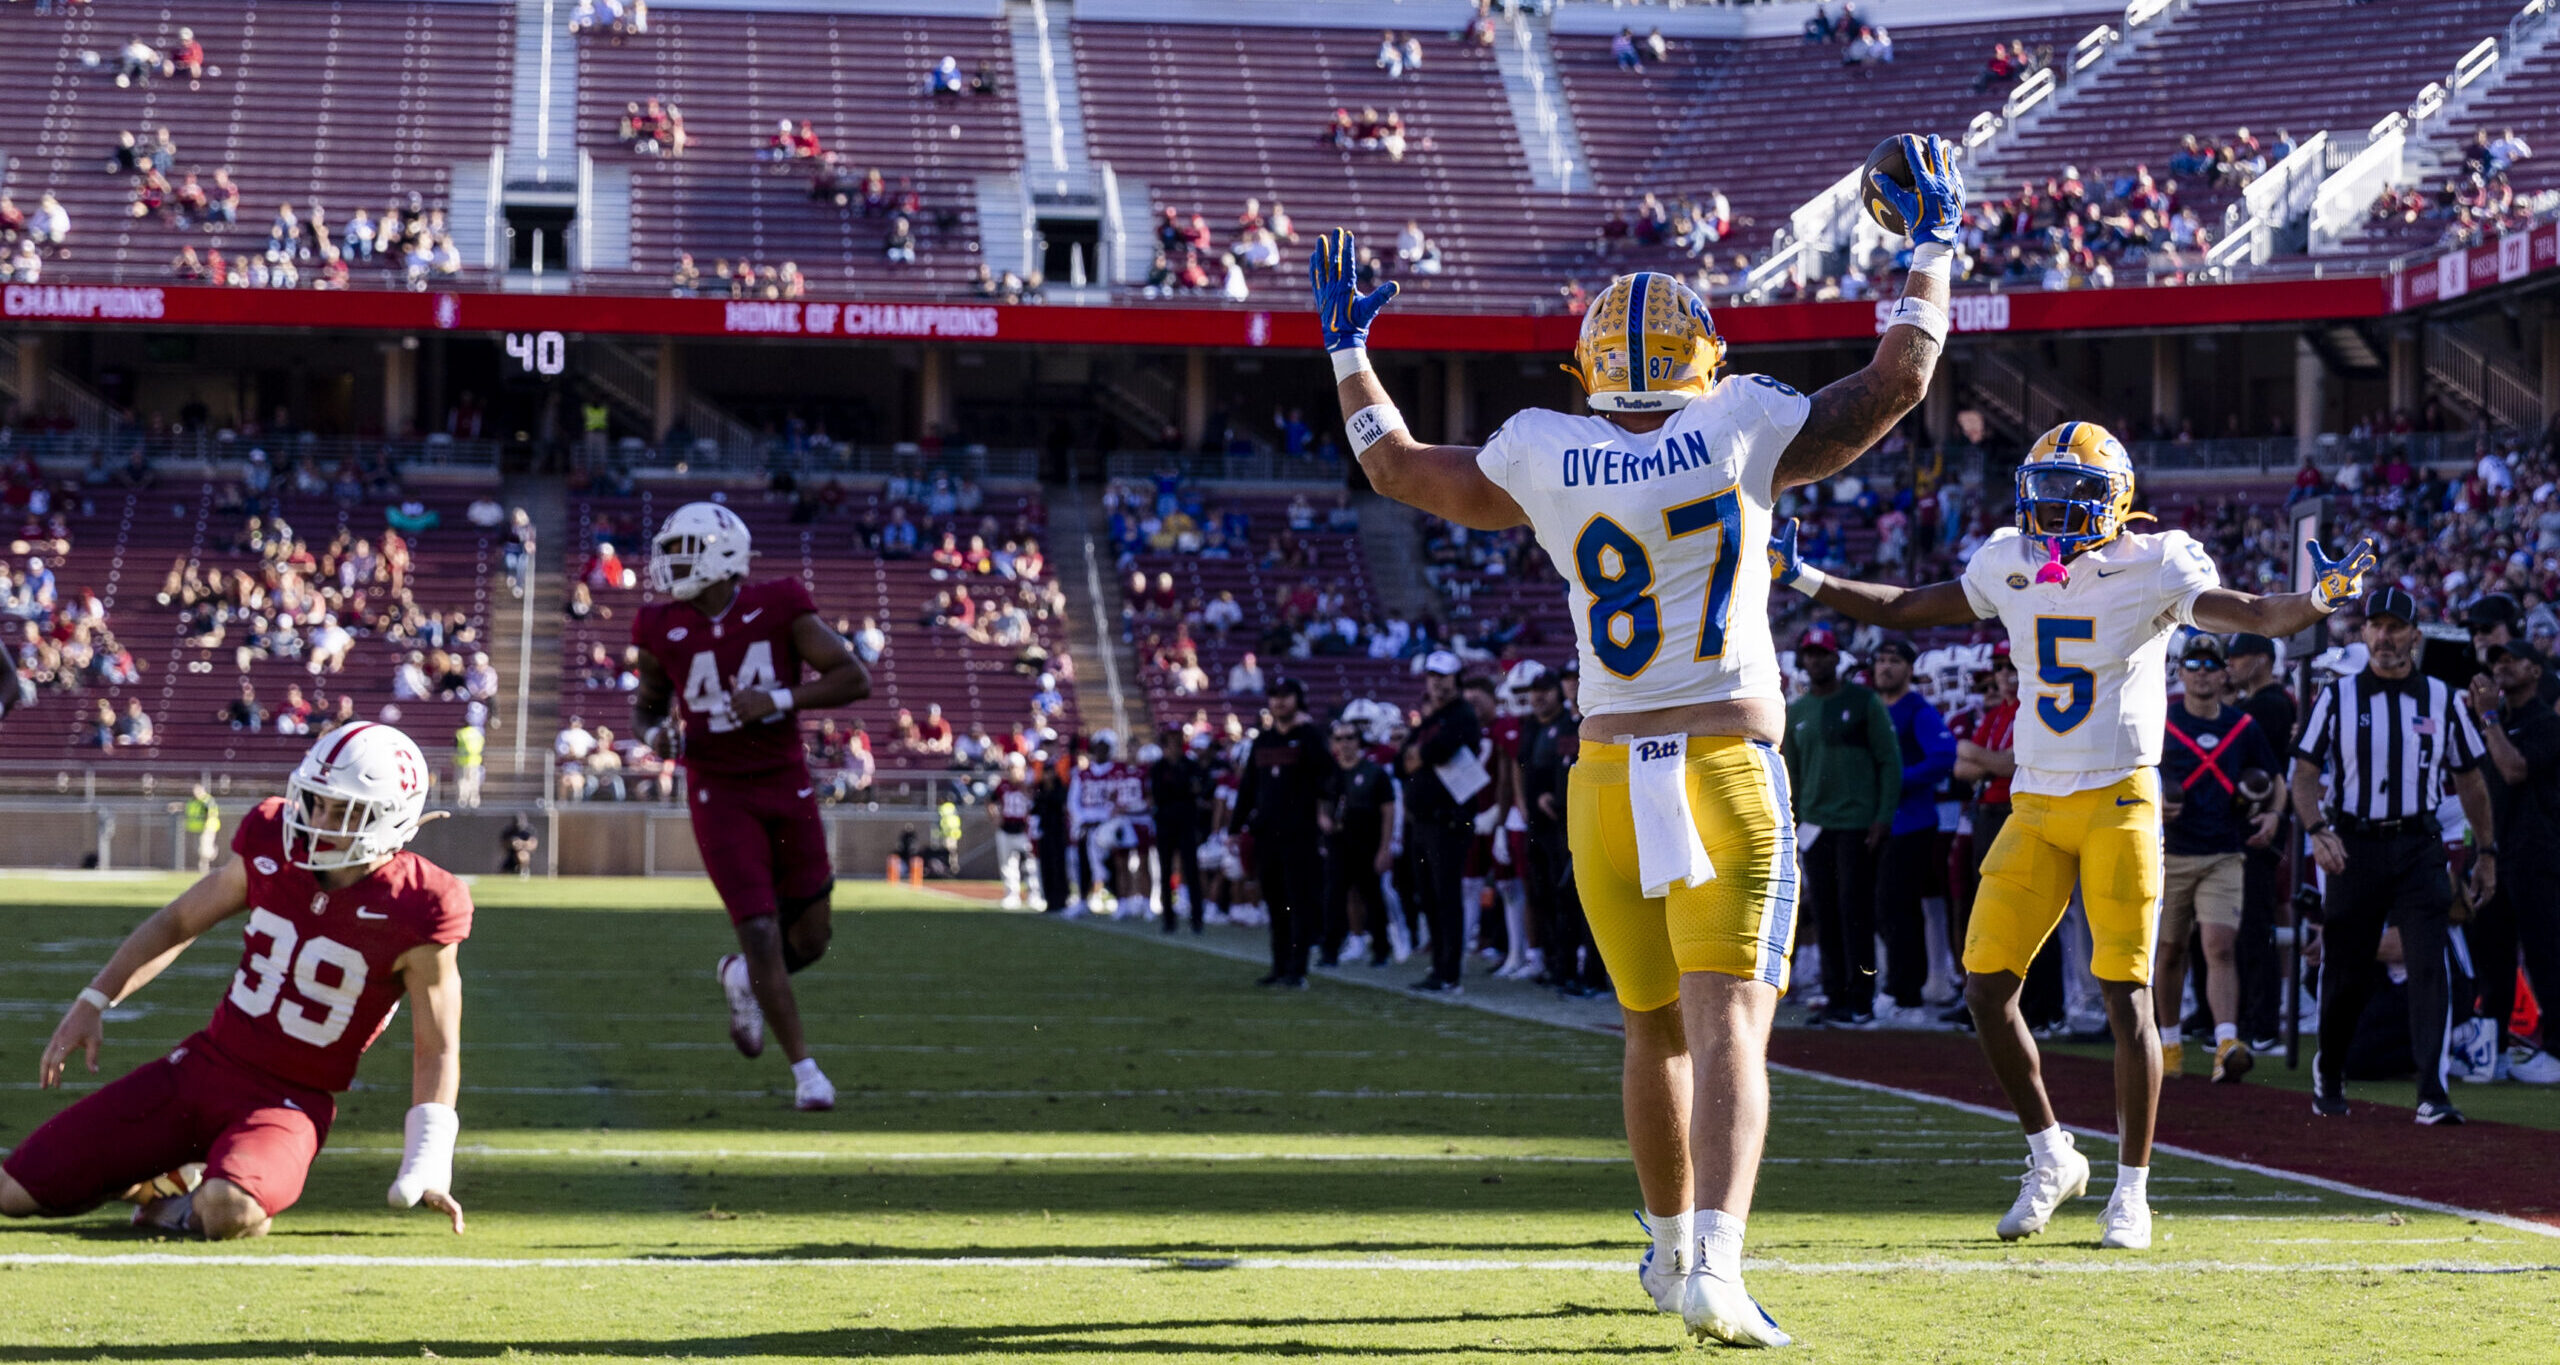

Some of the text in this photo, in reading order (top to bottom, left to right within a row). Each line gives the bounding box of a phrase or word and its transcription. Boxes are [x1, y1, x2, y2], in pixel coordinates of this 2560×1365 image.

[4, 284, 165, 318] CHAMPIONS
[725, 301, 998, 337] HOME OF CHAMPIONS
[506, 331, 565, 375] 40
[1649, 356, 1674, 380] 87
[1614, 396, 1662, 409] Panthers
[1353, 412, 1375, 434] 4:13
[1361, 424, 1384, 446] PHIL
[1562, 430, 1712, 487] OVERMAN
[1572, 483, 1745, 681] 87
[683, 640, 785, 733] 44
[2034, 614, 2096, 737] 5
[1636, 740, 1680, 762] Pitt
[2420, 749, 2430, 768] L
[229, 906, 369, 1048] 39
